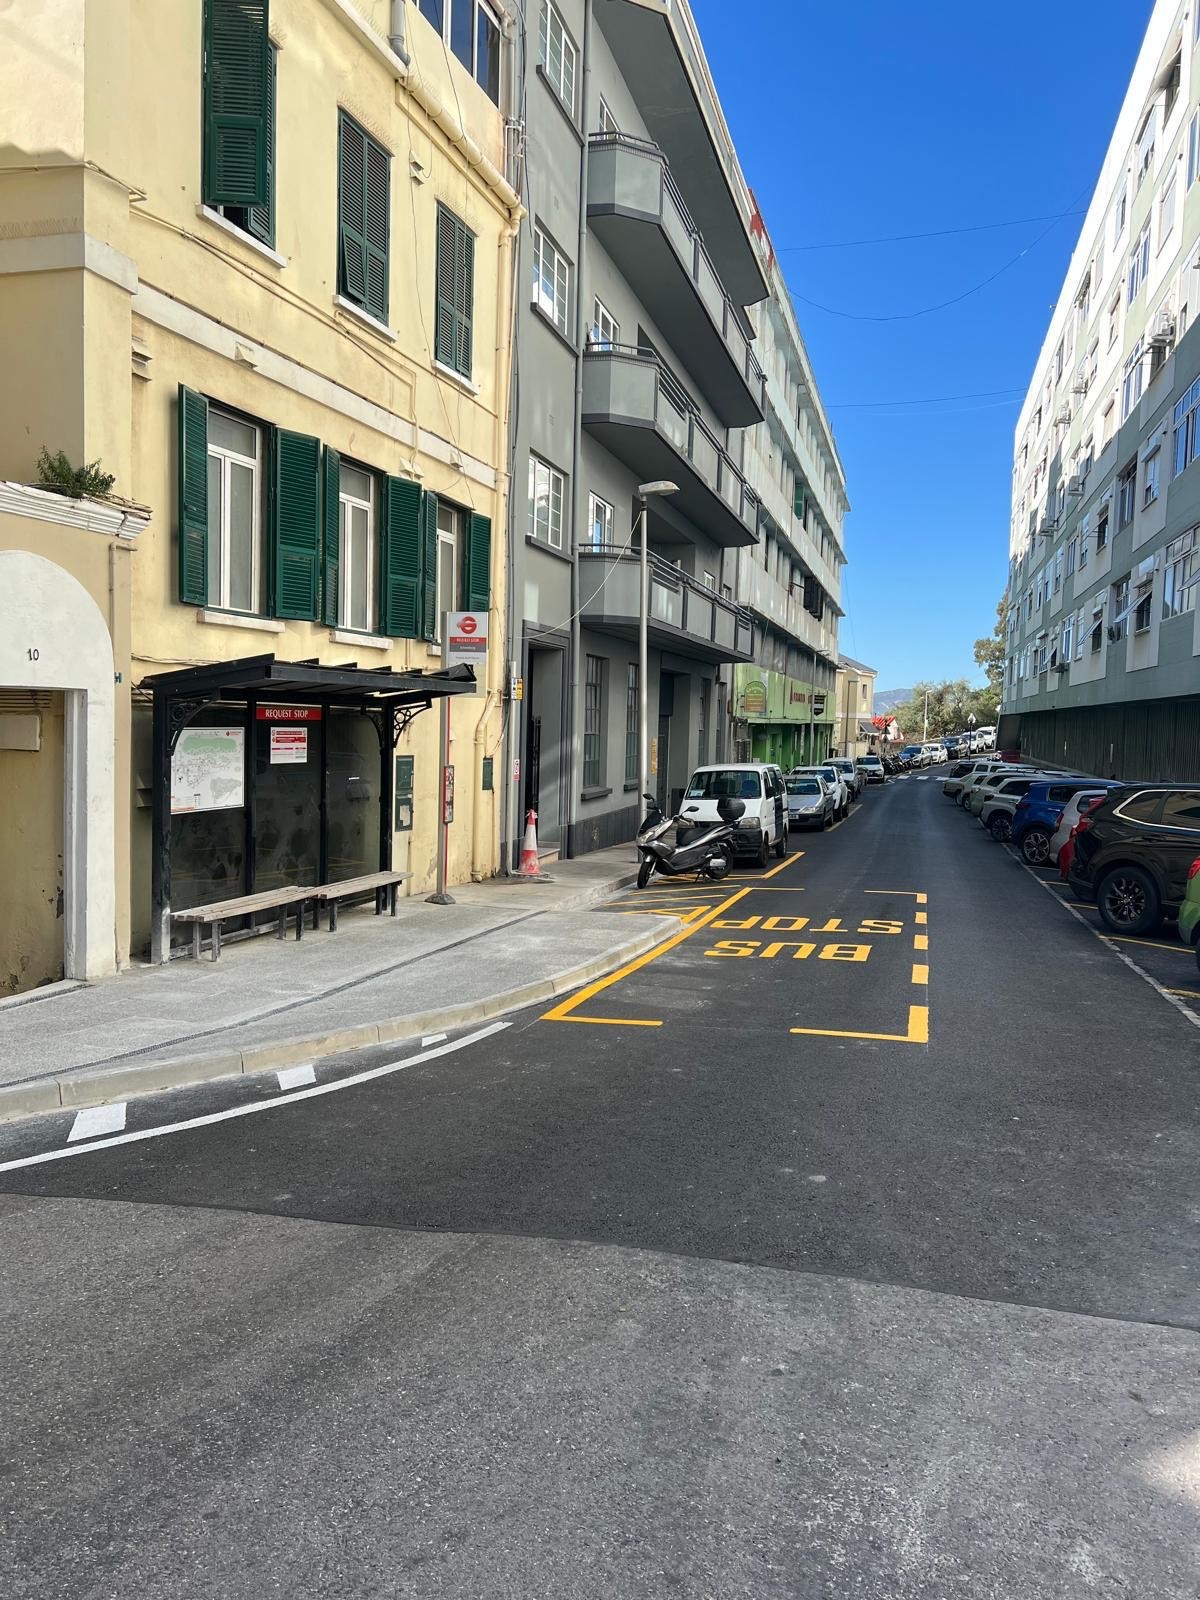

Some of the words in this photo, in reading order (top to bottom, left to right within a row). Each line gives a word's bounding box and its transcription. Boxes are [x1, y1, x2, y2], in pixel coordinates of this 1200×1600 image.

[27, 648, 39, 661] 10
[265, 708, 292, 719] REQUEST
[294, 709, 308, 718] STOP
[709, 915, 904, 934] STOP
[703, 940, 873, 962] BUS
